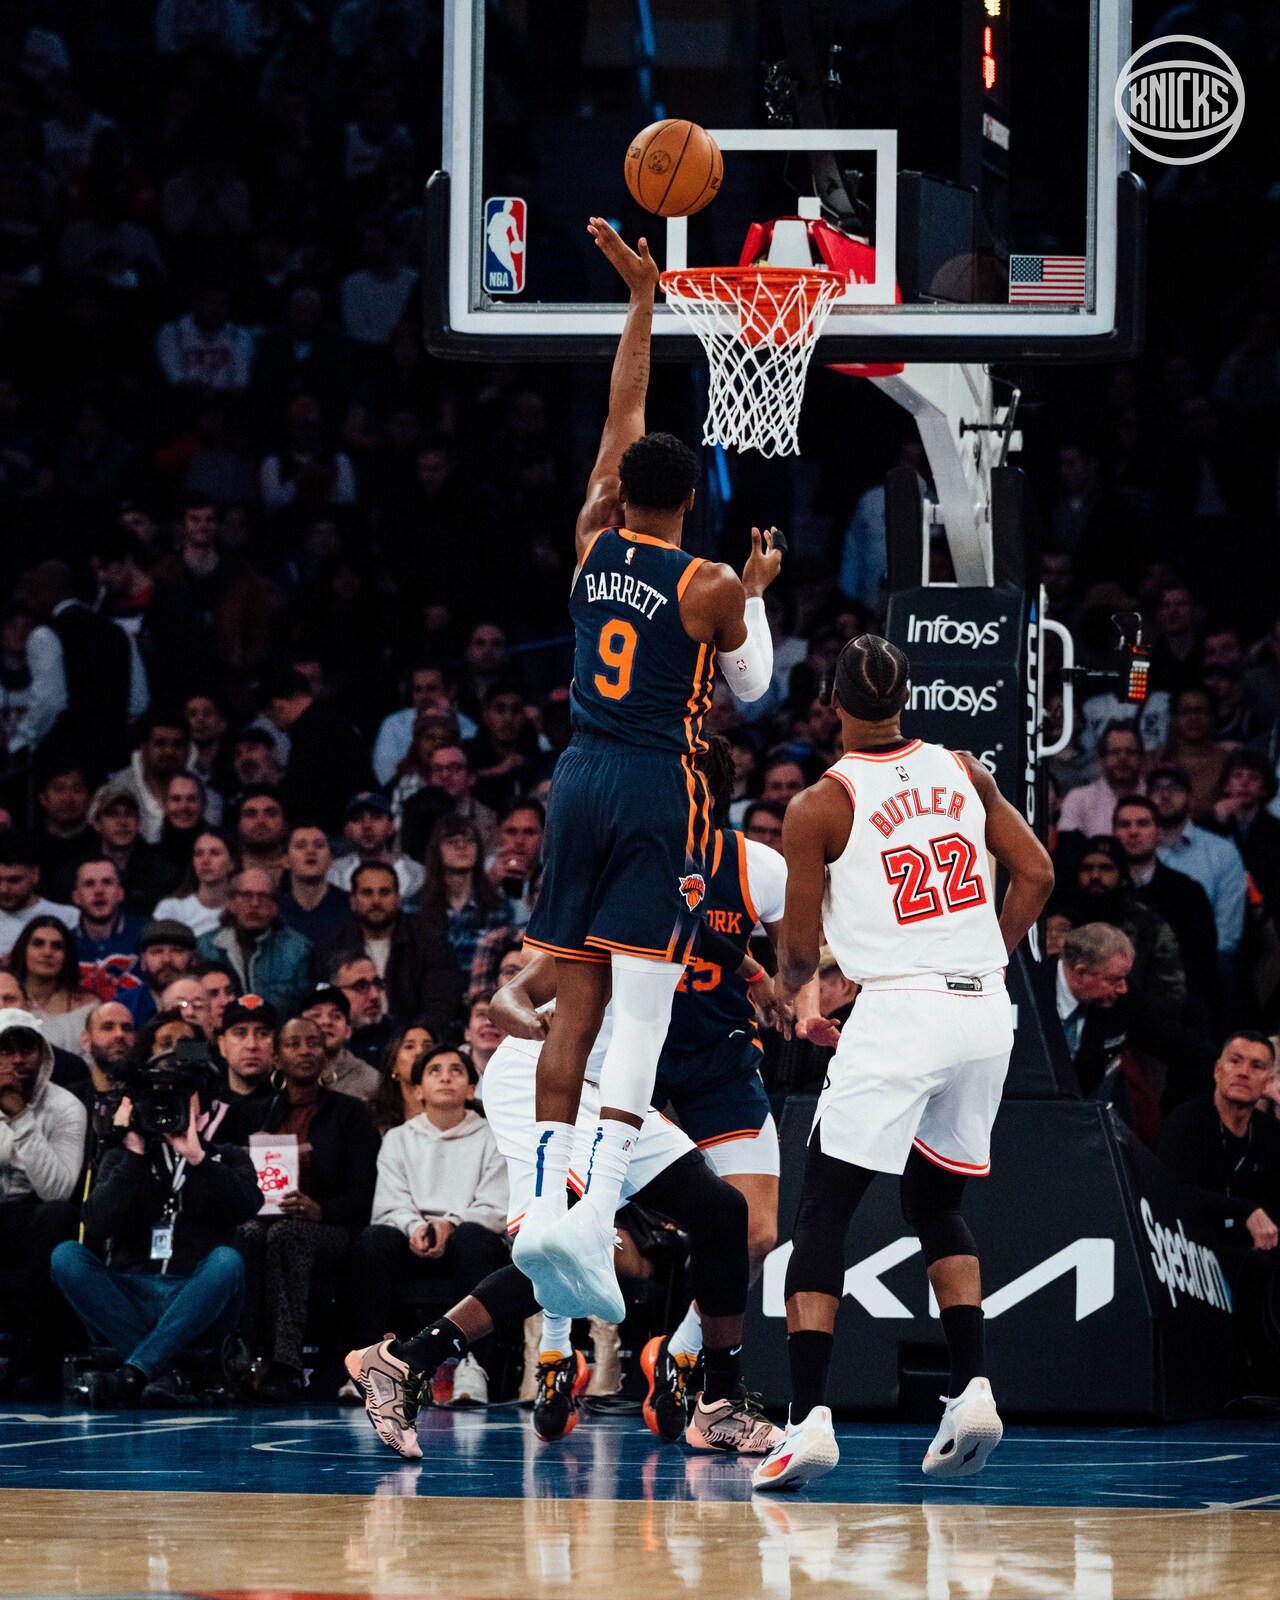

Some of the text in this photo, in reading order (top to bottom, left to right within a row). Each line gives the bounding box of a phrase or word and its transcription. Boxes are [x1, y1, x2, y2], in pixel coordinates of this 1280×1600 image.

[489, 271, 509, 288] NBA
[585, 572, 668, 621] BARRETT
[907, 614, 999, 650] Infosys
[594, 618, 638, 701] 9
[905, 679, 997, 717] Infosys
[869, 787, 966, 839] BUTLER
[880, 832, 987, 926] 22
[675, 956, 722, 993] 5
[1140, 1197, 1232, 1313] Spectrum
